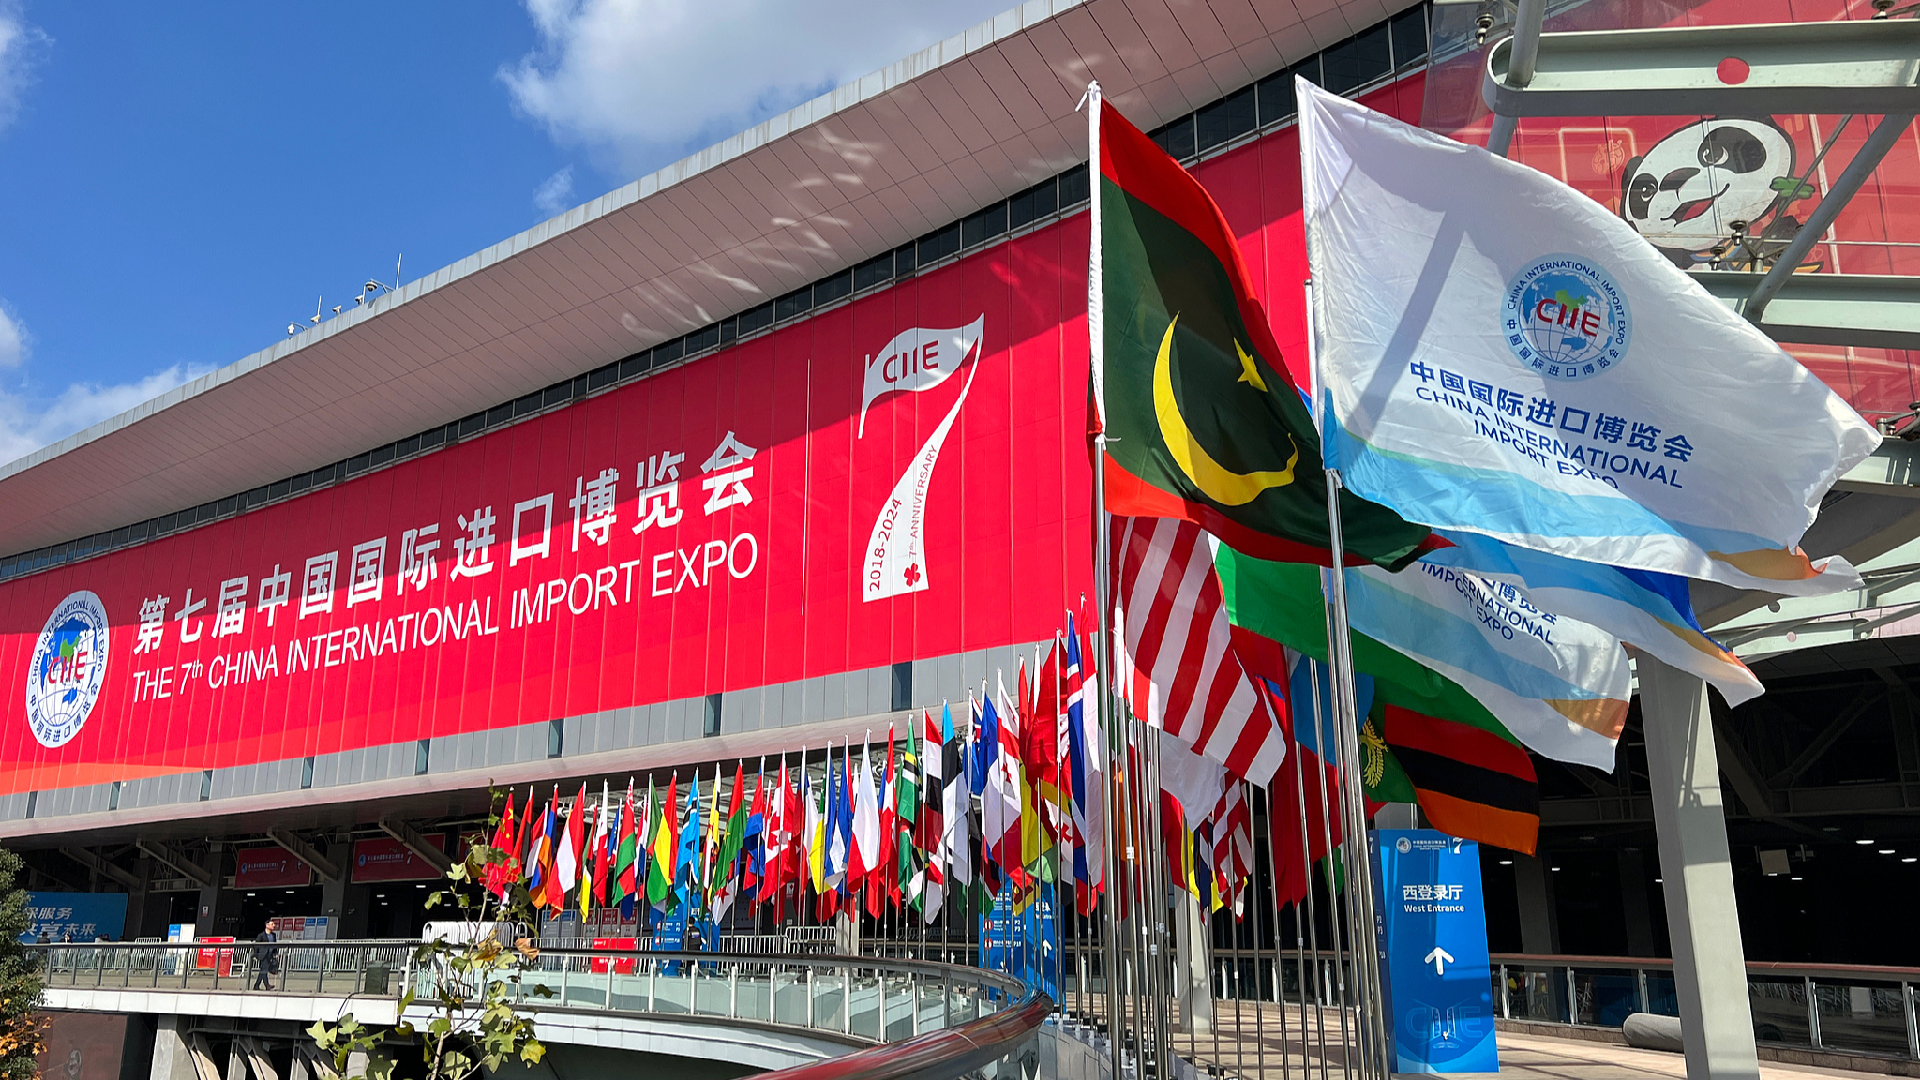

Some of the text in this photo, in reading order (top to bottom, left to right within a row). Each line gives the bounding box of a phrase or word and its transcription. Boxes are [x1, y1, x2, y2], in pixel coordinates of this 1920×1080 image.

[1507, 261, 1626, 345] CHINA INTERNATIONAL IMPORT EXPO
[1536, 298, 1600, 337] CIIE
[882, 340, 939, 383] CIIE
[1506, 319, 1619, 377] 中国国际进口博览会
[1410, 361, 1694, 463] 中国国际进口博览会
[1416, 387, 1684, 489] CHINA INTERNATIONAL
[1474, 419, 1550, 469] IMPORT
[910, 444, 938, 539] ANNIVERSARY
[133, 430, 758, 655] 第七届中国国际进口博览会
[869, 498, 902, 592] 2018-2024
[32, 649, 43, 685] CHINA
[42, 600, 89, 646] INTERNATIONAL
[97, 639, 105, 672] EXPO
[132, 532, 758, 703] THE 7th CHINA INTERNATIONAL IMPORT EXPO
[1421, 563, 1514, 641] IMPOT EXPO
[48, 651, 88, 684] CIIE
[1402, 884, 1463, 901] 西登录厅
[1404, 904, 1464, 912] West Entrance
